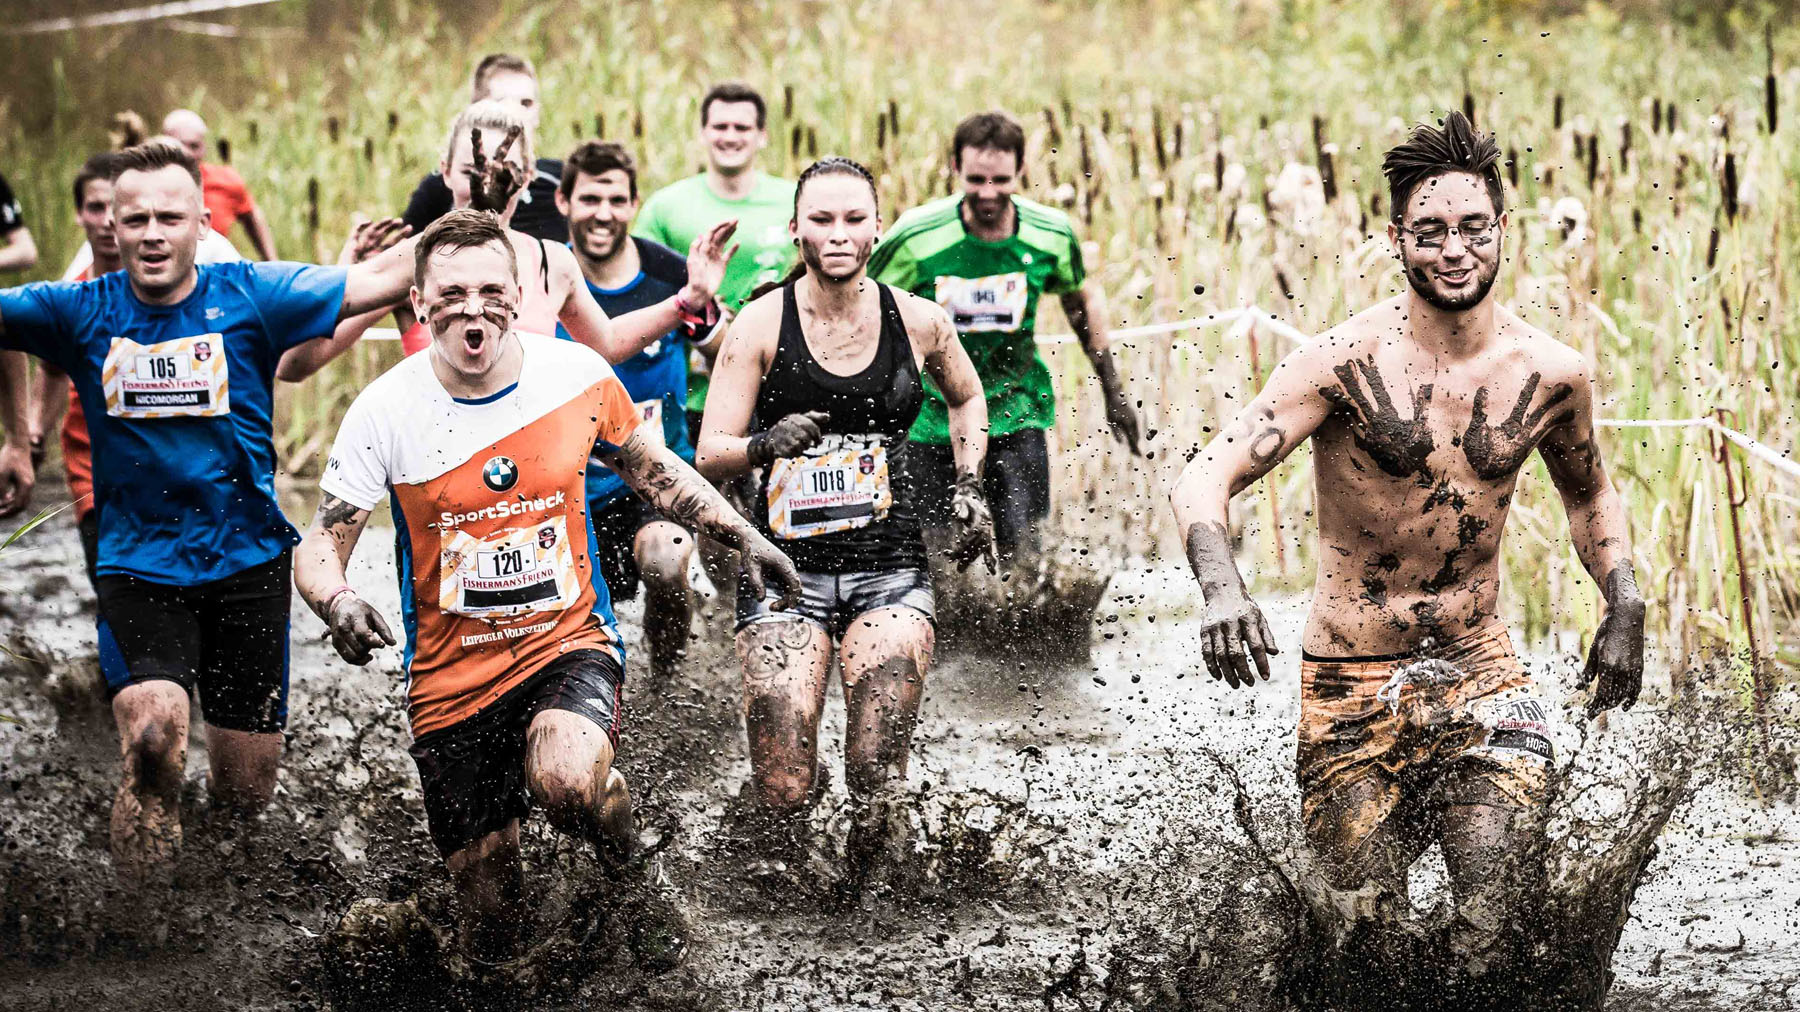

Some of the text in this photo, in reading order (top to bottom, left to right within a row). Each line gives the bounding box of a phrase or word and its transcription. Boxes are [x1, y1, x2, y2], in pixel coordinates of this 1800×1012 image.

[149, 357, 176, 379] 105
[811, 469, 845, 493] 1018
[440, 490, 566, 528] SportScheck
[493, 549, 523, 577] 120
[463, 568, 554, 590] FISHERMAN'S FRIEND
[460, 630, 504, 647] LEIPZIGER
